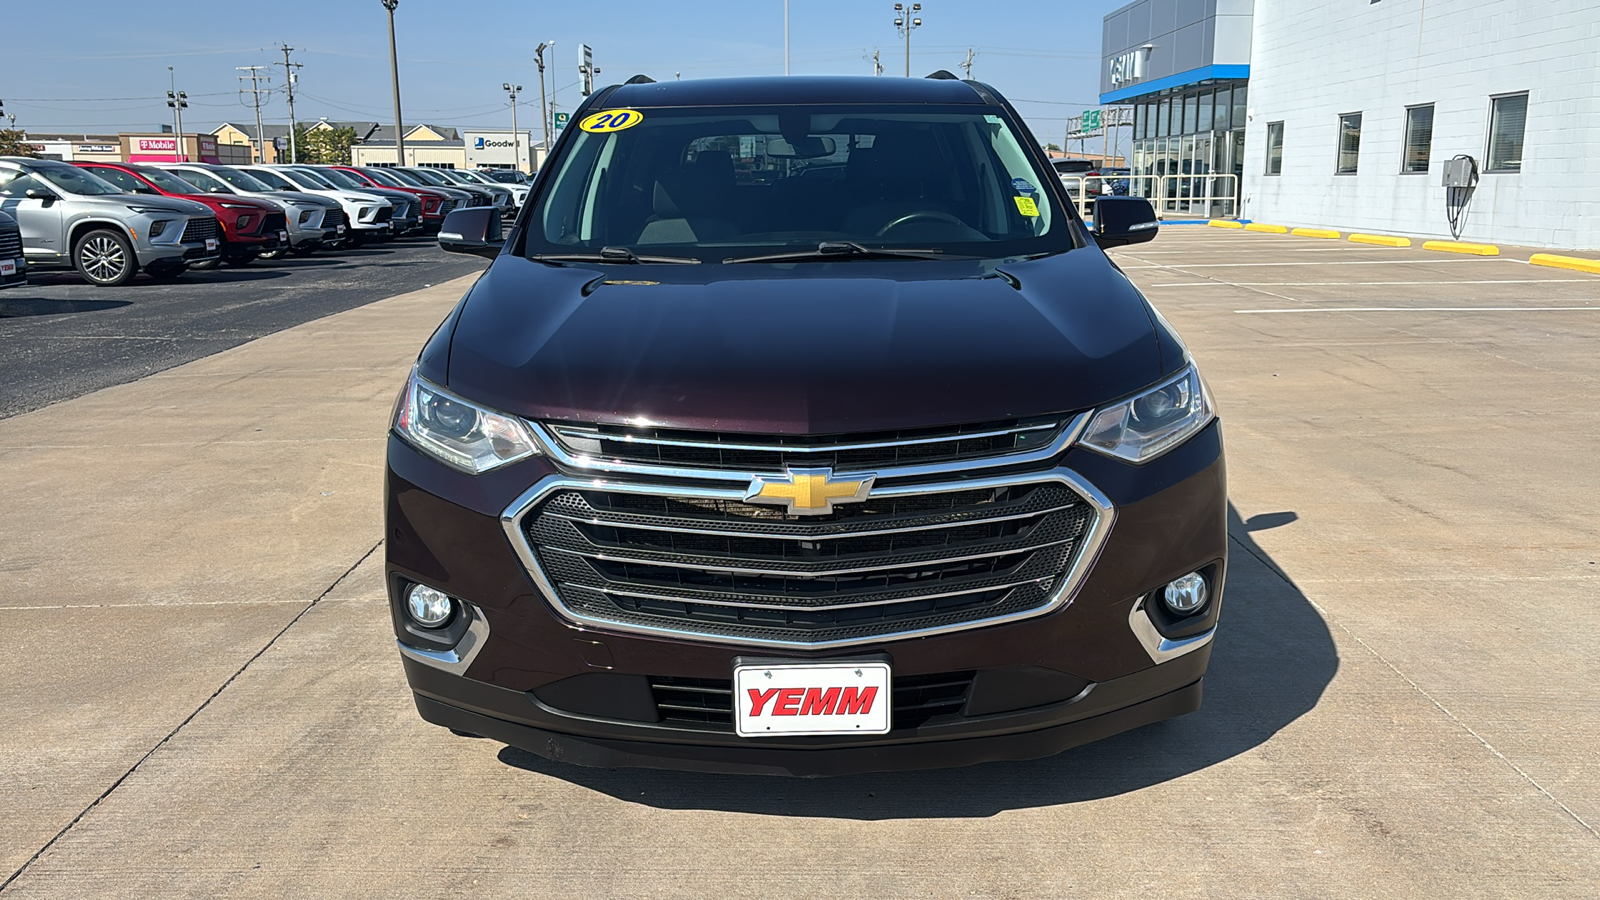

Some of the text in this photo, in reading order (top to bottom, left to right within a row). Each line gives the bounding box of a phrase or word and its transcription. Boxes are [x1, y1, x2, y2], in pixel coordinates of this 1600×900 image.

[590, 113, 630, 129] 20
[485, 139, 520, 147] Goodwl
[747, 686, 879, 717] YEMM
